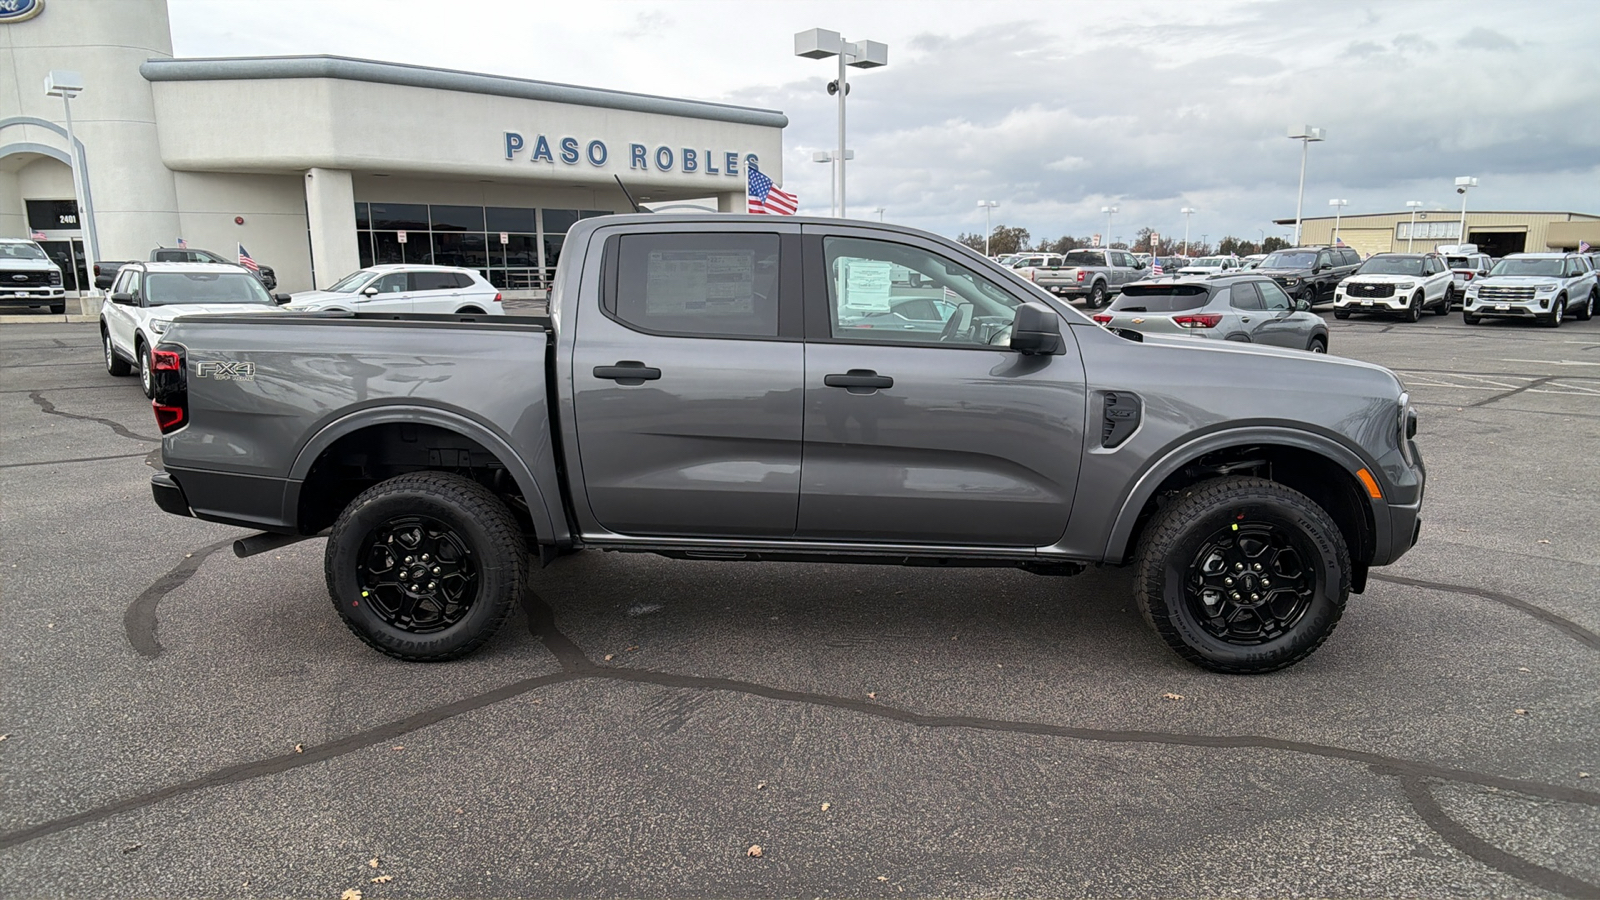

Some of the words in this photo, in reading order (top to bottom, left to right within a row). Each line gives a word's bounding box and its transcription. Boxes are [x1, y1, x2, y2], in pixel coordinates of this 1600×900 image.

[503, 131, 609, 167] PASO
[629, 142, 760, 176] ROBLES
[60, 215, 77, 224] 2401
[196, 361, 255, 378] FX4
[1298, 517, 1330, 554] TERRITORY
[372, 628, 462, 652] RANGLER
